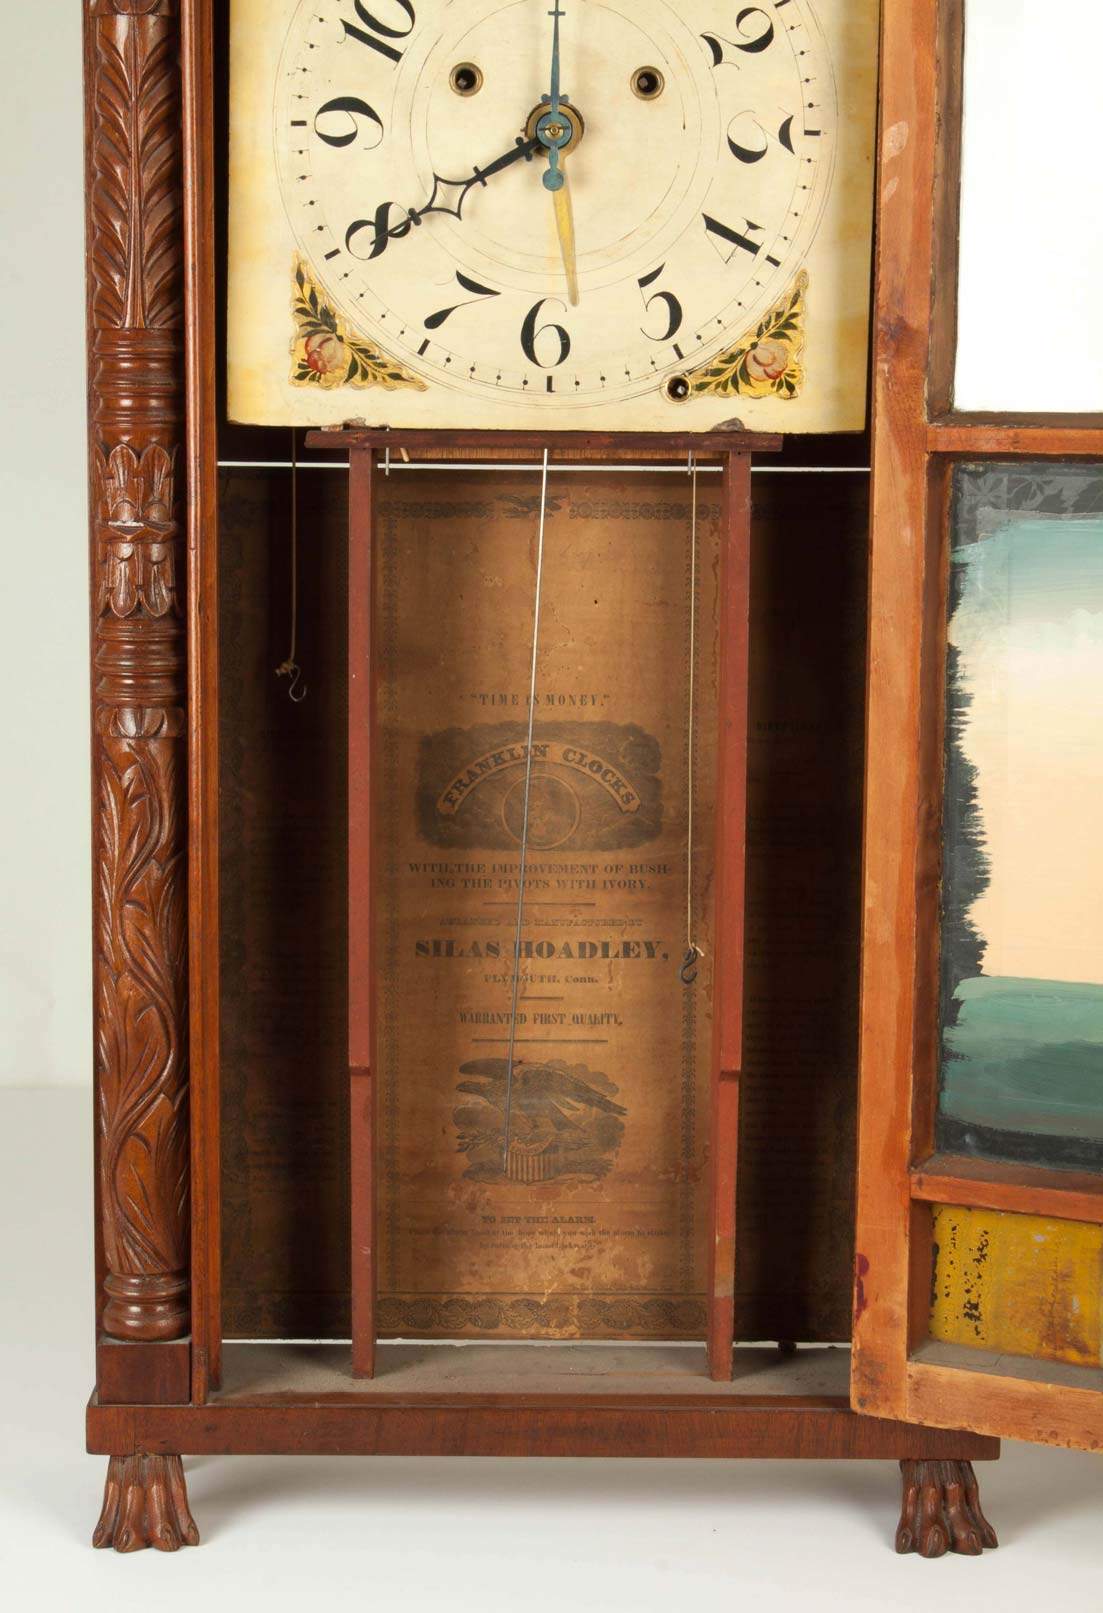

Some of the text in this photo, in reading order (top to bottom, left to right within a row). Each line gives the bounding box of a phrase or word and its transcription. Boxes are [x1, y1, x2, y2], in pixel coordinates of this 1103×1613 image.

[700, 6, 775, 70] 2
[313, 95, 385, 150] 9
[345, 201, 411, 260] 8
[701, 212, 765, 264] 4
[423, 269, 501, 330] 7
[637, 263, 683, 342] 5
[520, 297, 572, 369] 6
[443, 743, 636, 806] FRANKLIN CLOCKS
[431, 878, 455, 889] ING
[460, 878, 493, 889] THE
[555, 879, 596, 889] WITH
[491, 863, 600, 874] IMPROVEMENT
[603, 863, 624, 874] OF
[414, 940, 501, 959] SILAS
[532, 1012, 566, 1025] FIRST
